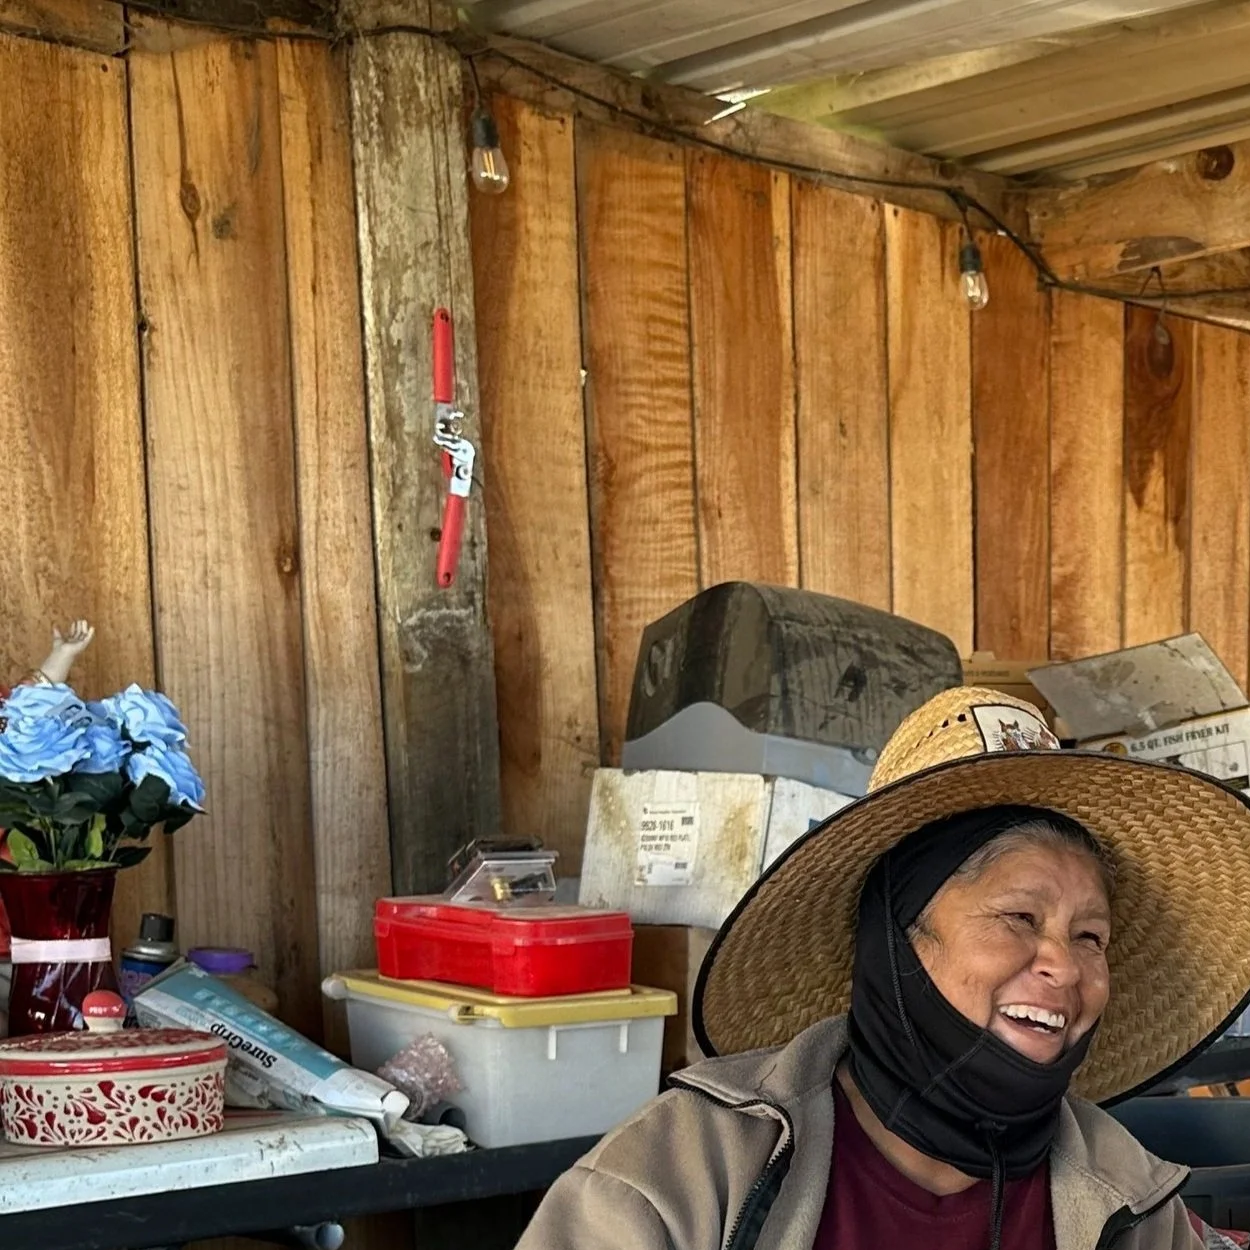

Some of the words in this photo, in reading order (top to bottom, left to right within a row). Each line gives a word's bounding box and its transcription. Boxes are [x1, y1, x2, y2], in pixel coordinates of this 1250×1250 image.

[1163, 733, 1183, 745] FISH
[1186, 728, 1213, 741] FRYER
[1214, 723, 1230, 735] KIT
[209, 1022, 278, 1069] SureGrip
